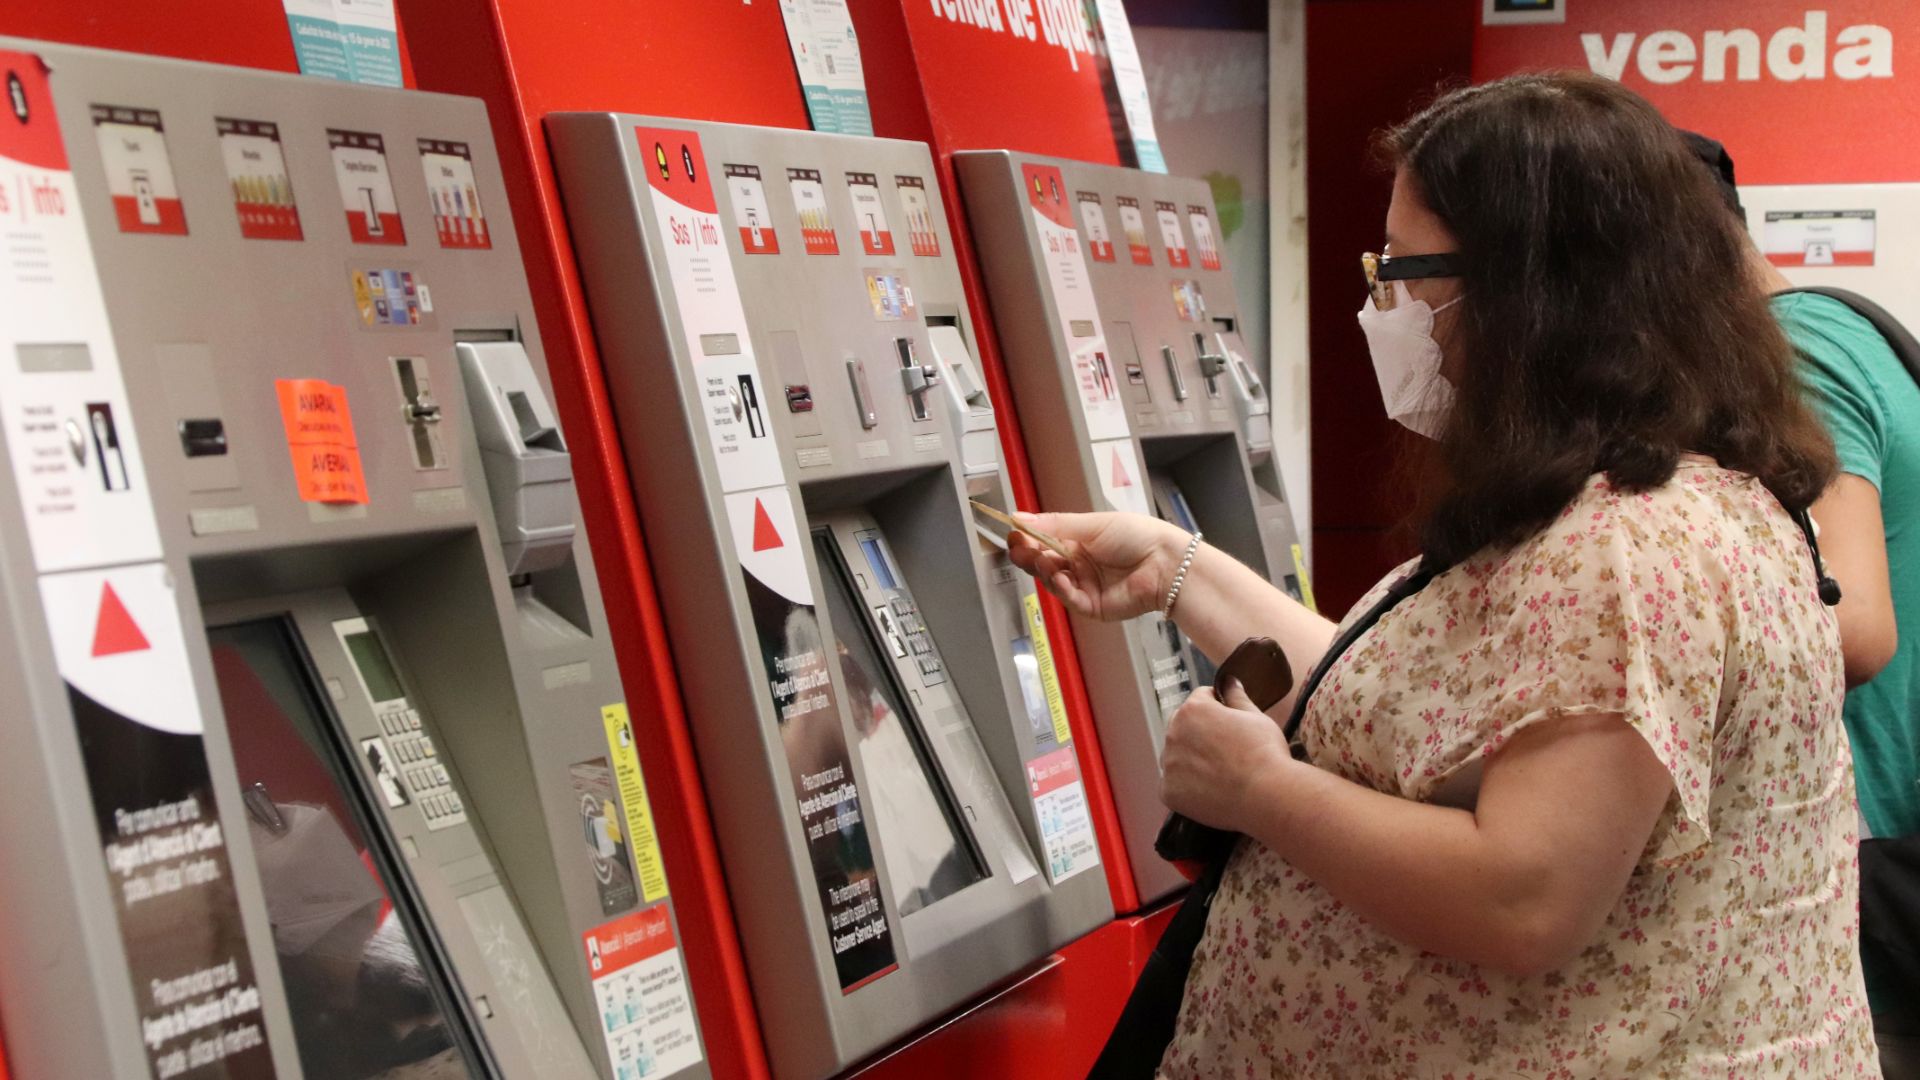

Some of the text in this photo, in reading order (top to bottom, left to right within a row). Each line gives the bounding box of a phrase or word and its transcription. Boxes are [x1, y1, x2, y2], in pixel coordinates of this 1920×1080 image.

[1580, 10, 1894, 84] venda
[670, 215, 691, 245] Sos
[697, 217, 718, 245] Info
[829, 888, 840, 906] The
[860, 878, 871, 896] may
[831, 913, 840, 930] be
[838, 907, 851, 928] used
[854, 902, 867, 923] speak
[870, 896, 879, 913] the
[833, 933, 857, 954] Customer
[854, 922, 873, 944] Service
